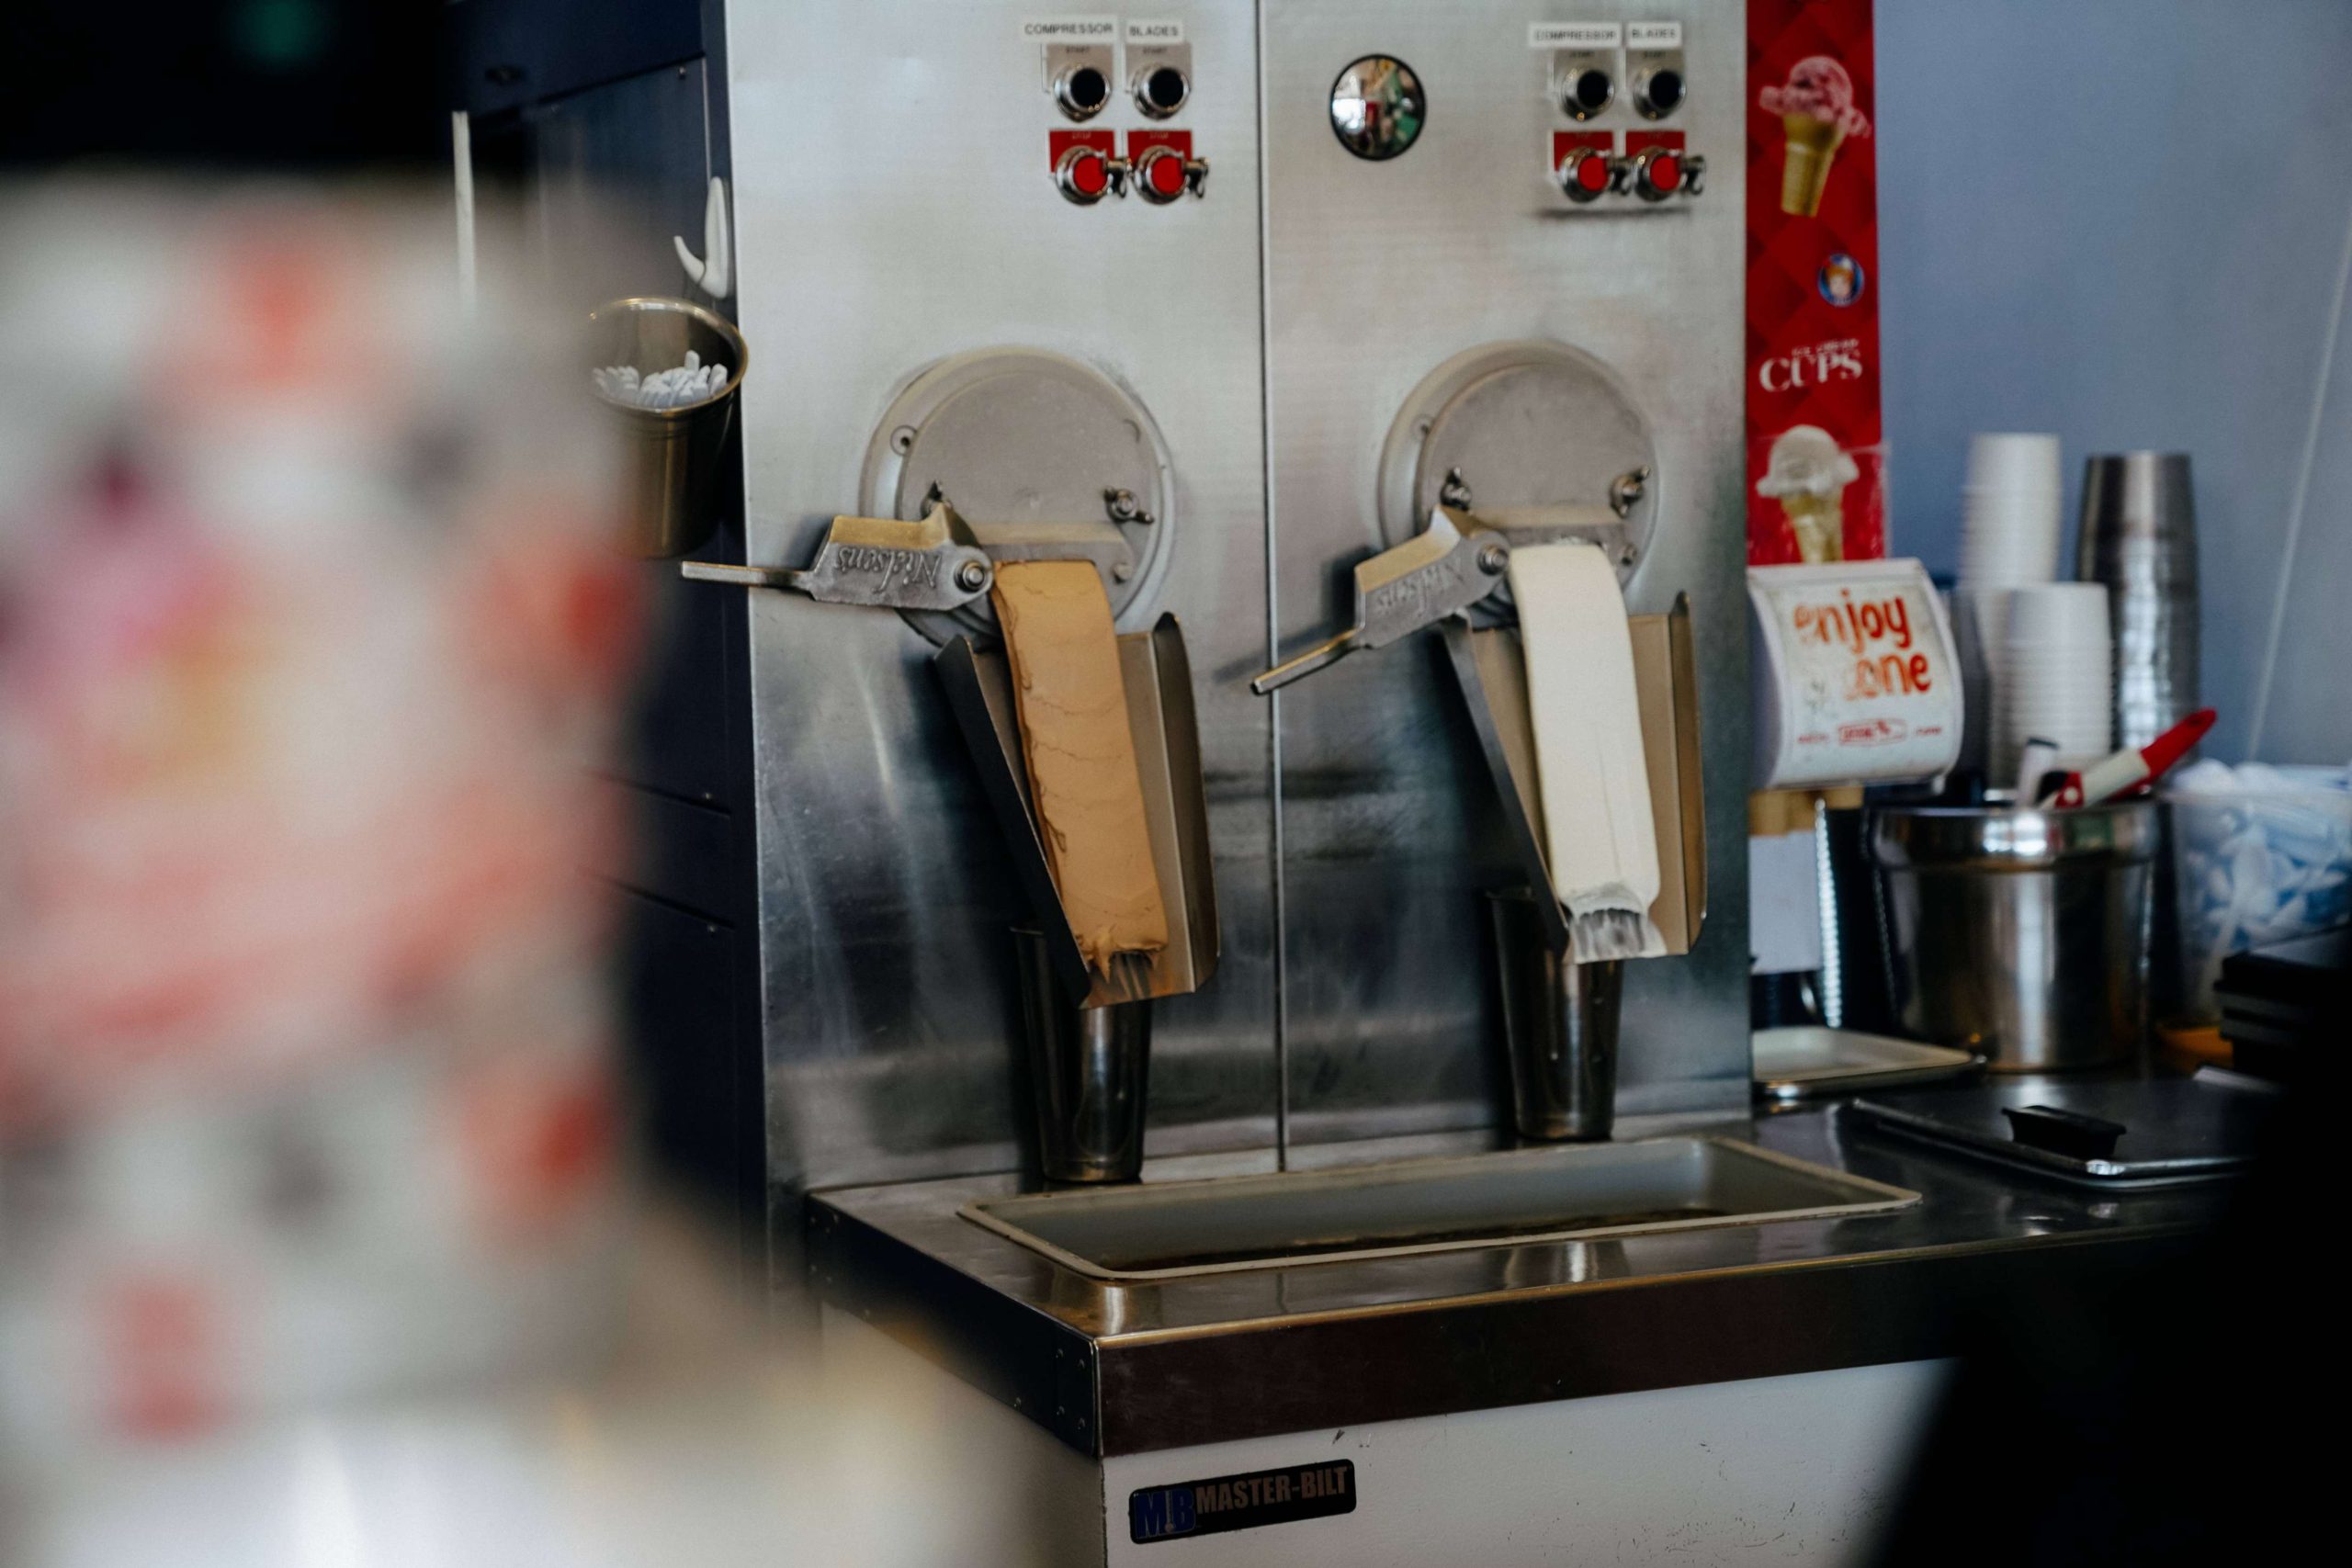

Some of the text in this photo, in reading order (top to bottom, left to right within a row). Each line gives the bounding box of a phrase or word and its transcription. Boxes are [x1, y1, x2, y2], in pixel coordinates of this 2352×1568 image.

[1023, 22, 1114, 35] COMPRESSOR
[1129, 25, 1179, 37] BLADES
[1631, 28, 1677, 39] BLADES
[1758, 348, 1863, 393] CUPS
[1793, 588, 1913, 654] enjoy
[1843, 653, 1933, 702] one
[1195, 1466, 1348, 1515] MASTER-BILT
